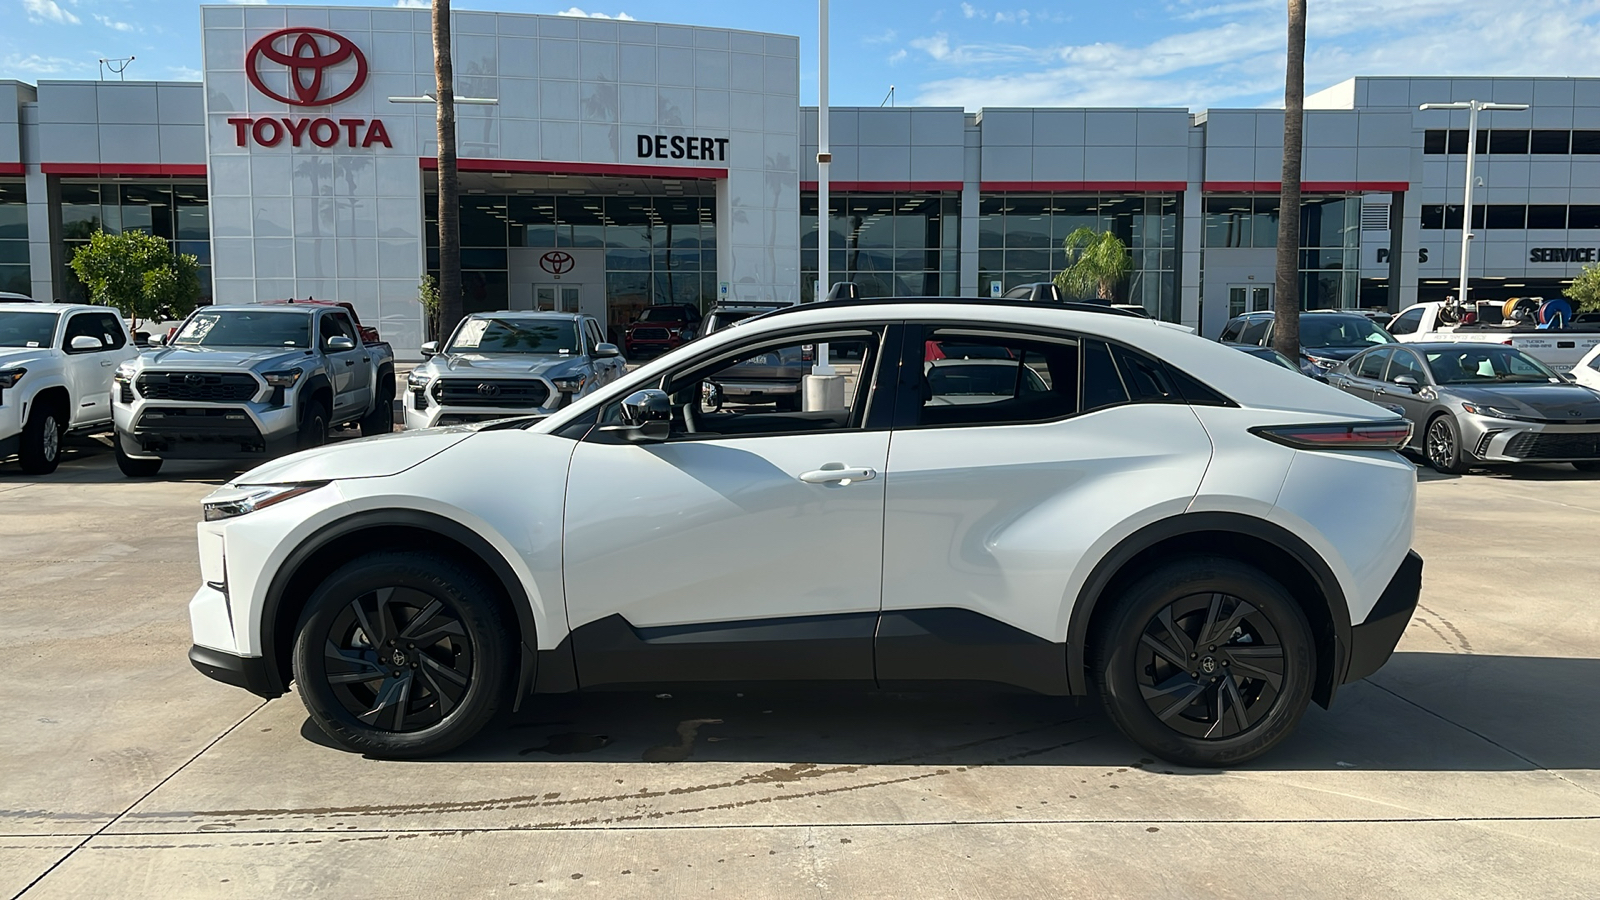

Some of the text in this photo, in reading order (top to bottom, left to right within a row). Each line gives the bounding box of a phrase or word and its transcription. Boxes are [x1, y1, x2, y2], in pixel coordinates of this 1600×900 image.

[228, 117, 393, 148] TOYOTA
[637, 134, 729, 161] DESERT
[1530, 247, 1596, 263] SERVICE
